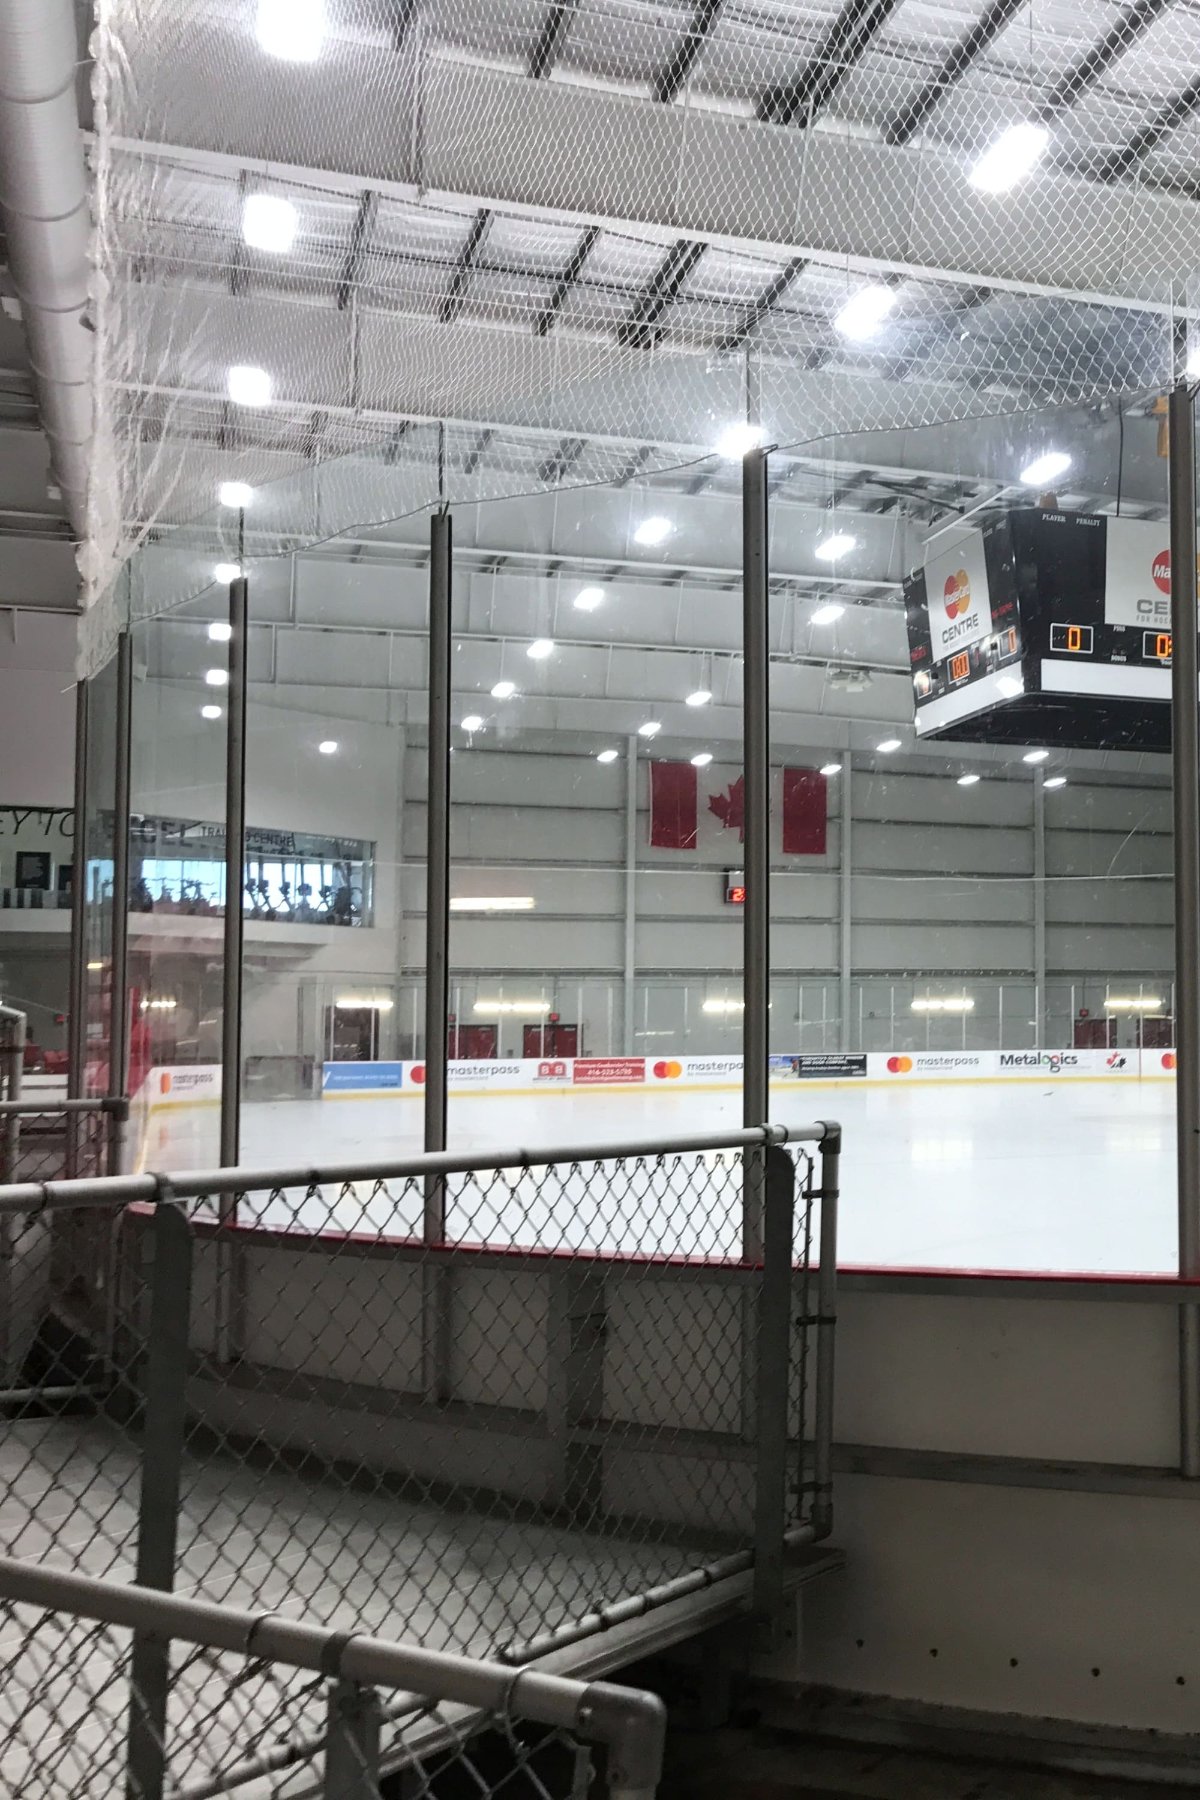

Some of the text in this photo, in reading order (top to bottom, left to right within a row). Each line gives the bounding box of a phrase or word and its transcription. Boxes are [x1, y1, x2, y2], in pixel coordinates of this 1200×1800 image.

[942, 613, 979, 643] CENTRE
[687, 1061, 744, 1072] masterpa
[917, 1056, 980, 1067] masterpass
[1000, 1052, 1078, 1073] Metalogics
